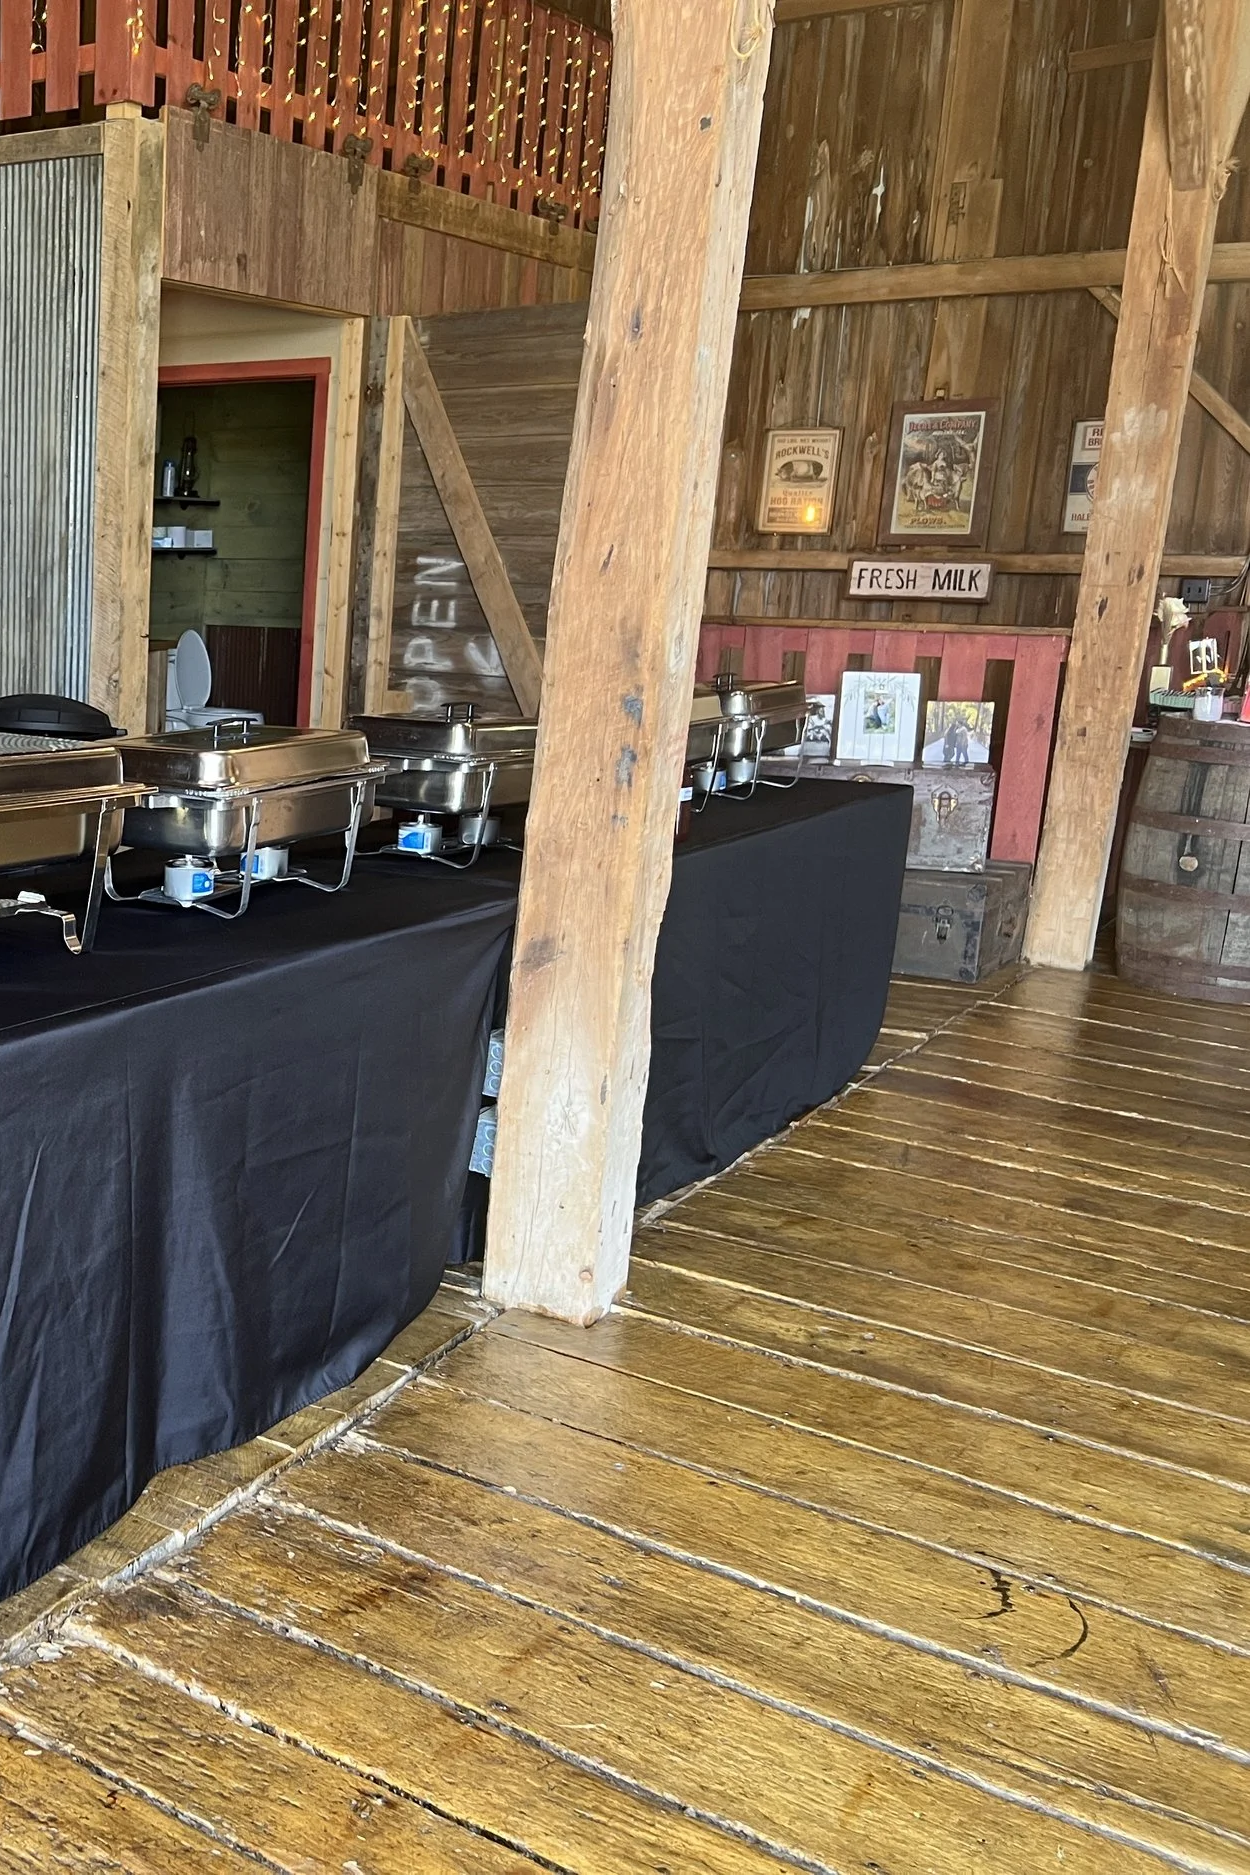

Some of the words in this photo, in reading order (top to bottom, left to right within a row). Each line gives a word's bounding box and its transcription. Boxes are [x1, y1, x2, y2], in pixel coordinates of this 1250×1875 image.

[775, 445, 830, 460] ROCKWELL'S
[857, 568, 918, 590] FRESH
[932, 568, 981, 592] MILK
[403, 556, 465, 711] OPEN
